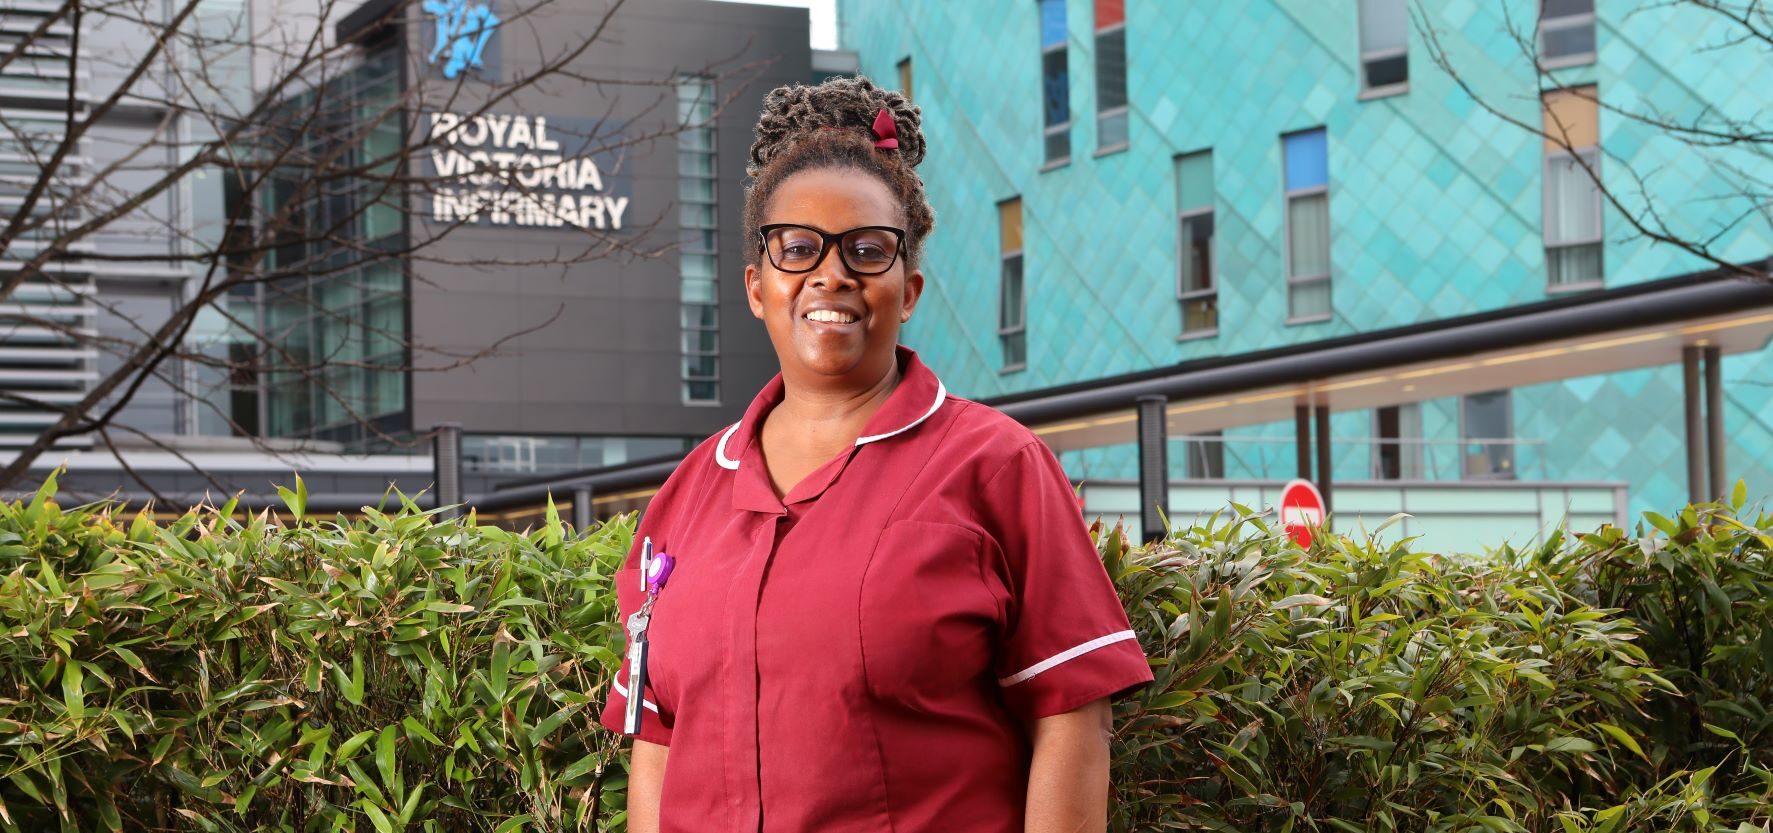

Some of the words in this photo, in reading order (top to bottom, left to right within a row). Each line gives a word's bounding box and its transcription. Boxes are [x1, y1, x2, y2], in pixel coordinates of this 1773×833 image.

[431, 112, 559, 150] ROYAL
[432, 149, 603, 191] VICTORIA
[432, 187, 629, 230] INFIRMARY
